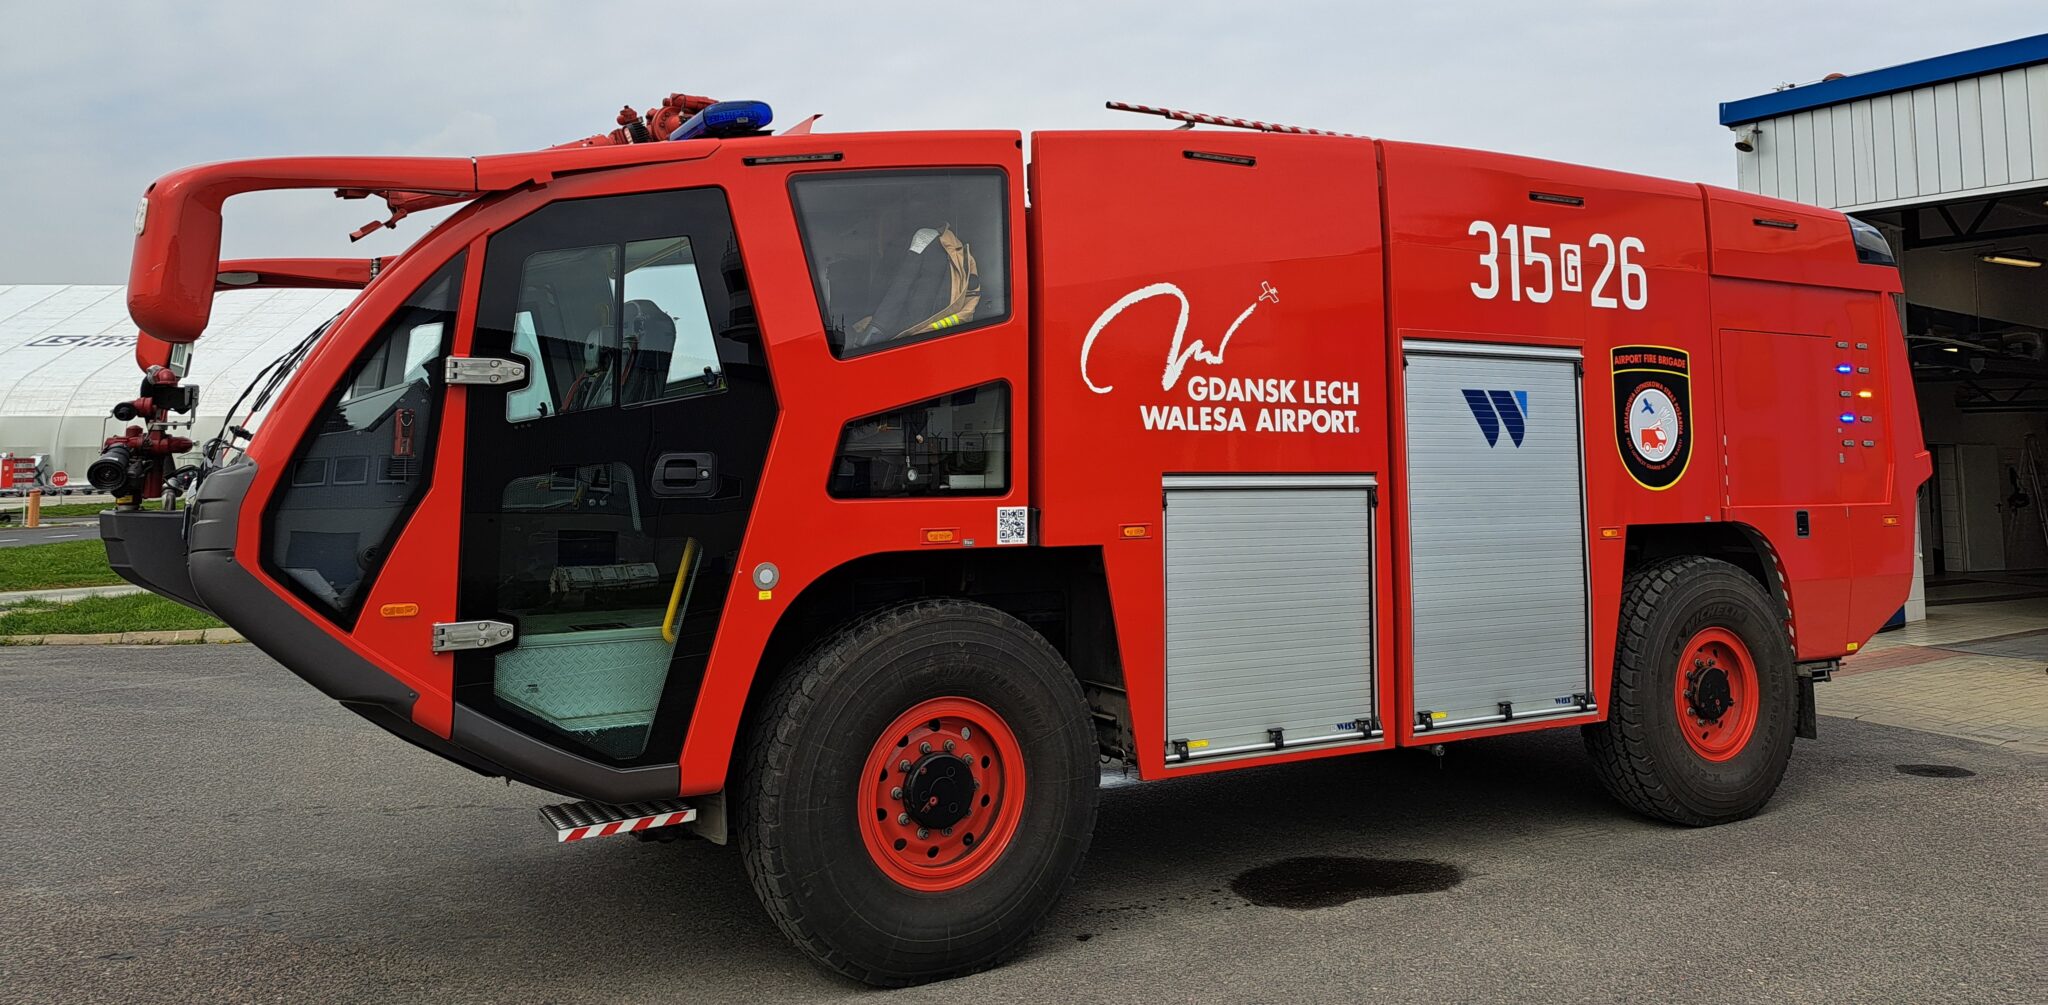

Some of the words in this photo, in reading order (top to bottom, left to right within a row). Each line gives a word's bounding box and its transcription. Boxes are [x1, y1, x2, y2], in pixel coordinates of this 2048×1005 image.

[1468, 220, 1553, 304] 315
[1562, 245, 1580, 289] G
[1588, 233, 1648, 310] 26
[1614, 354, 1642, 365] AIRPORT
[1643, 354, 1657, 364] FIRE
[1658, 355, 1686, 368] BRIGADE
[1187, 375, 1298, 404] GDANSK
[1303, 380, 1359, 405] LECH
[1140, 405, 1247, 432] WALESA
[53, 475, 67, 483] STOP
[1336, 721, 1357, 731] WISS
